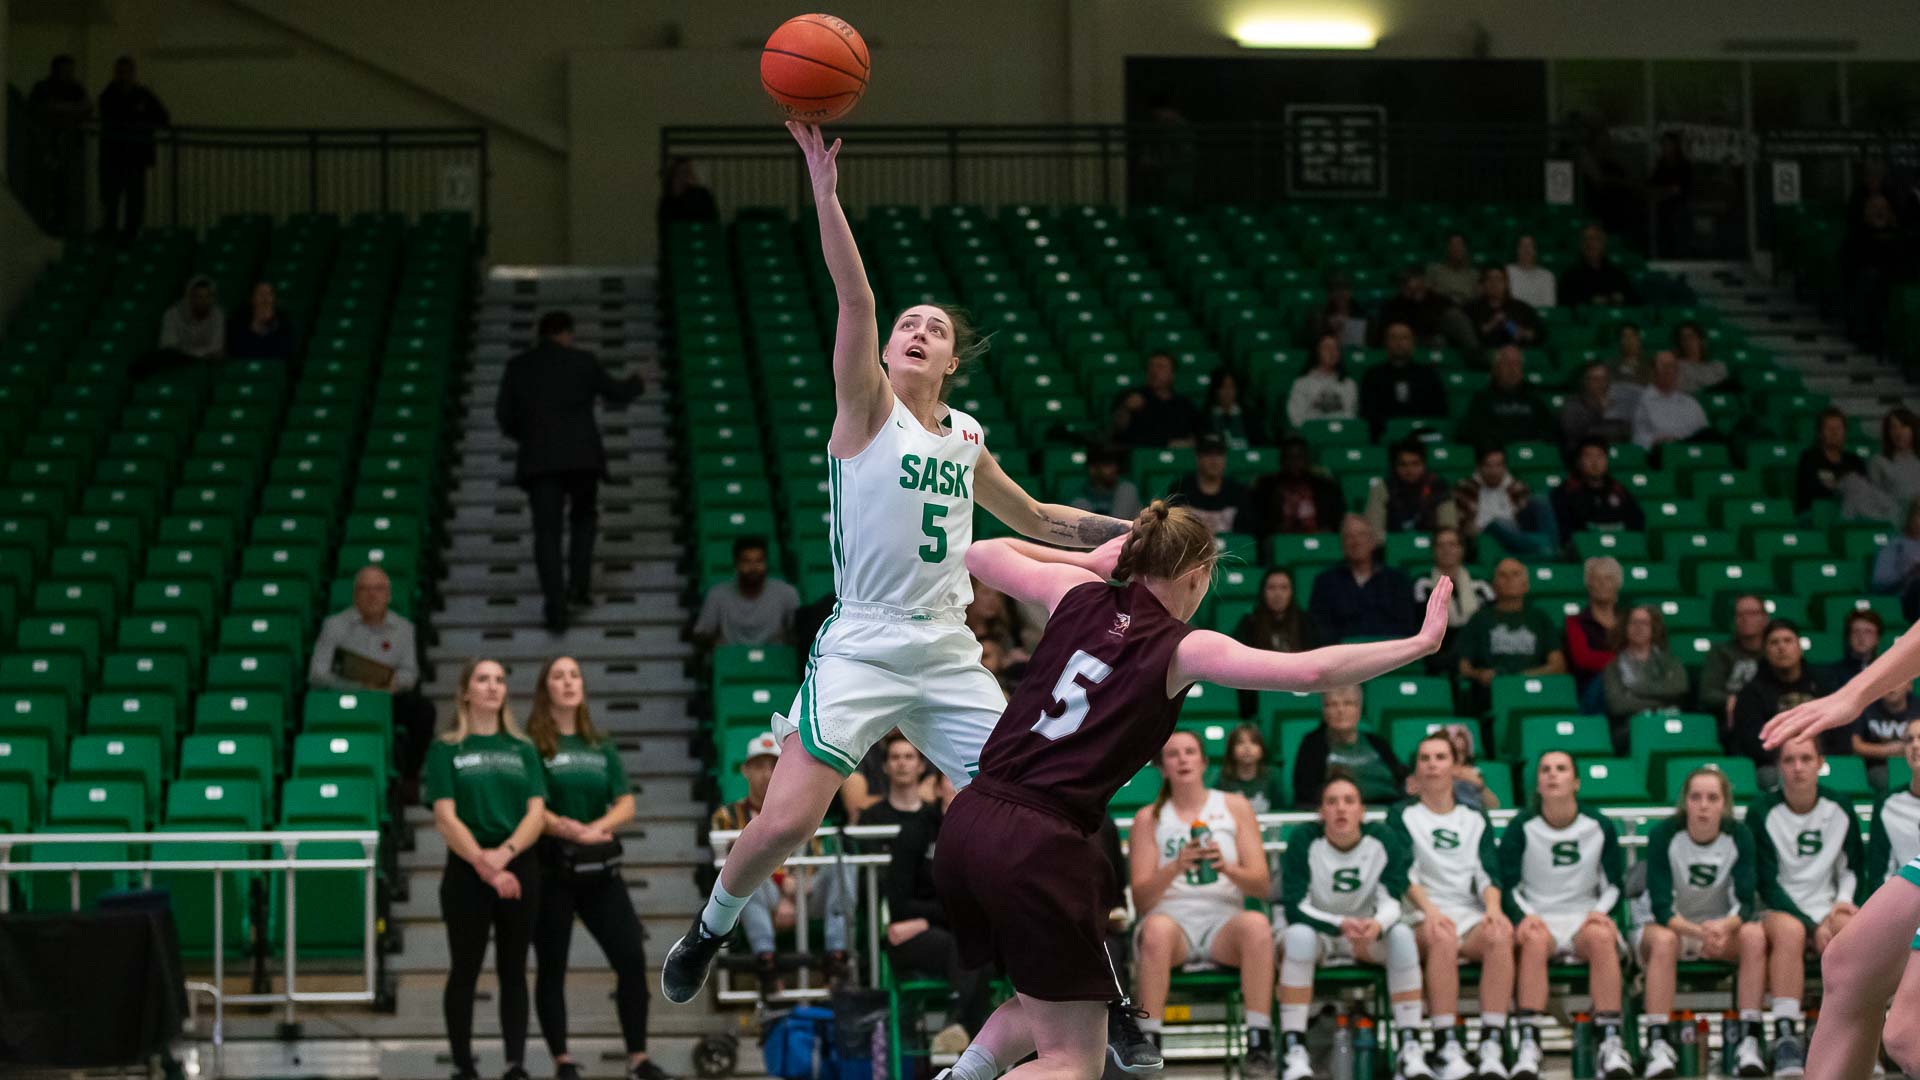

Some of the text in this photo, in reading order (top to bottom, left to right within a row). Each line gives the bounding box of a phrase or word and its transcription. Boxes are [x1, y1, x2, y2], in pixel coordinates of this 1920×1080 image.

[900, 454, 969, 499] SASK
[919, 503, 948, 563] 5
[1030, 649, 1114, 740] 5
[1432, 829, 1460, 849] S
[1797, 831, 1822, 855] S
[1553, 841, 1581, 866] S
[1332, 868, 1361, 893] S
[1690, 865, 1717, 886] S
